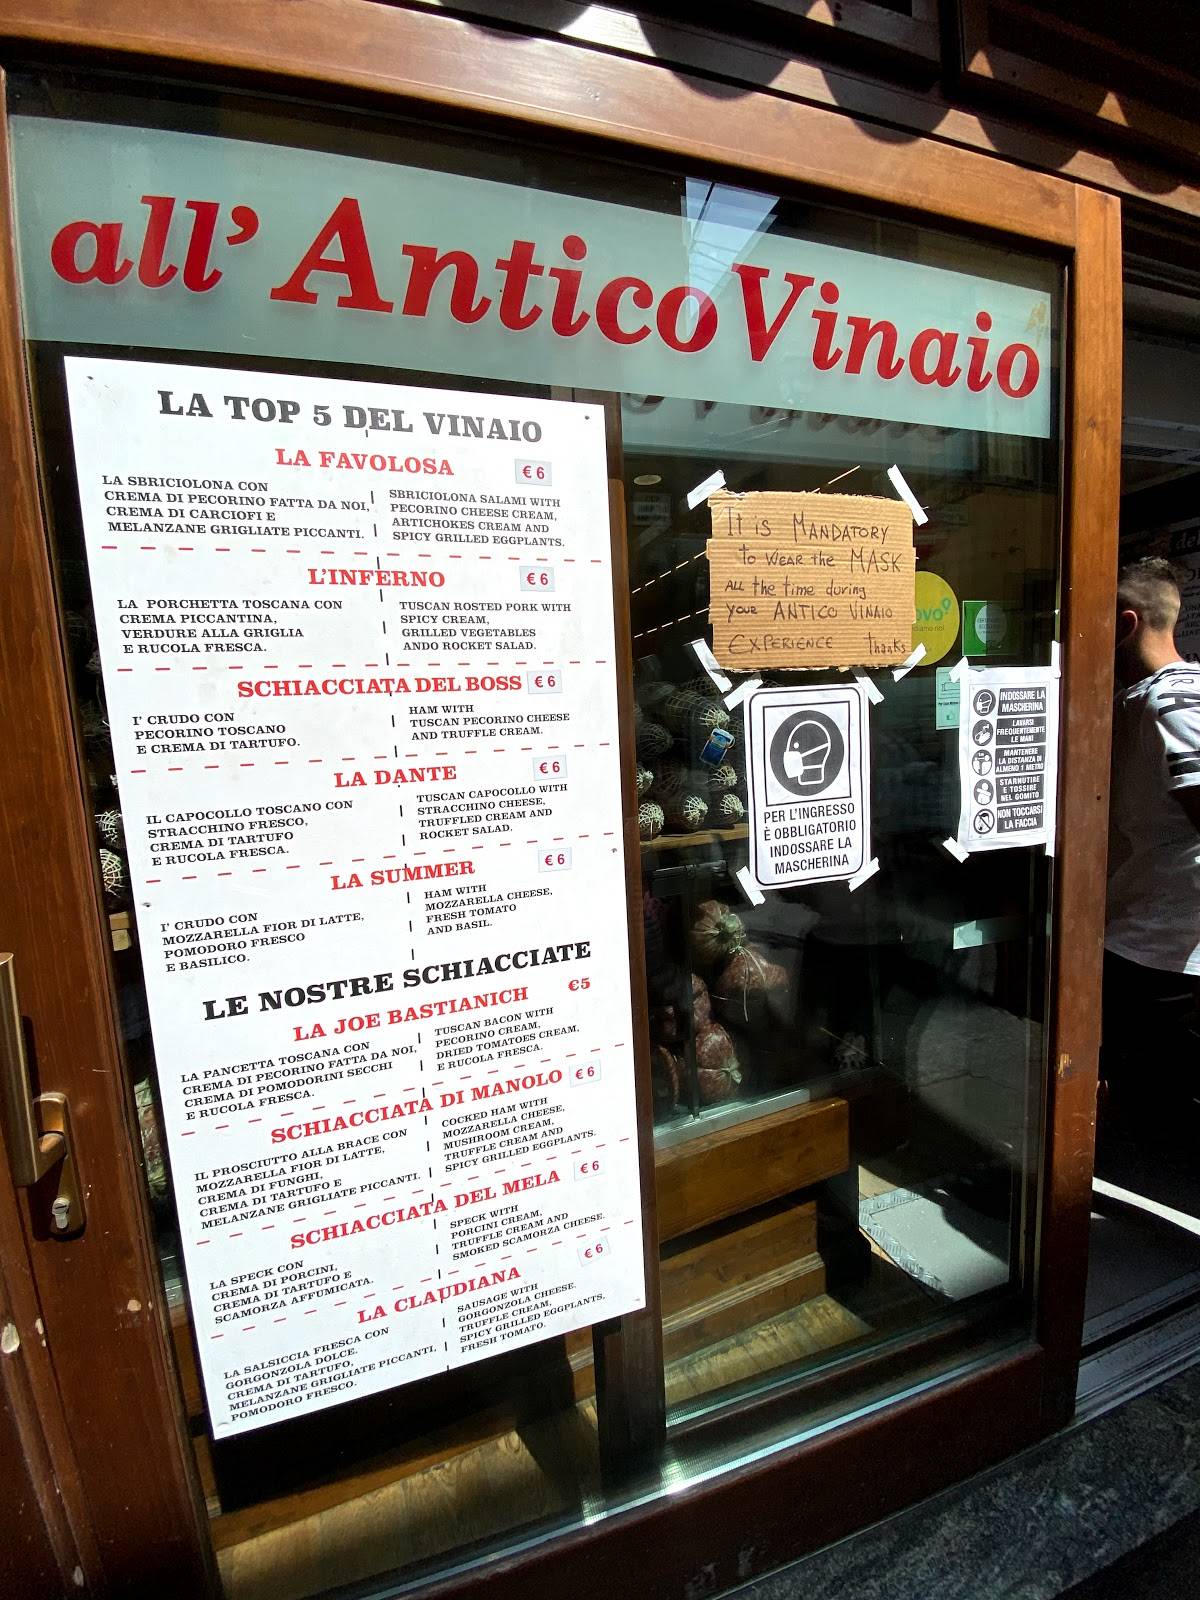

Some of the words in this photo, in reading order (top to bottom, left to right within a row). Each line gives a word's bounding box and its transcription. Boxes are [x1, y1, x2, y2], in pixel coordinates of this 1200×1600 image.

[50, 194, 260, 293] all’
[269, 196, 719, 353] Antico
[731, 262, 1041, 399] Vinaio
[157, 390, 213, 418] LA
[223, 395, 300, 424] TOP
[312, 404, 332, 426] 5
[342, 405, 413, 432] DEL
[422, 412, 542, 443] VINAIO
[274, 448, 311, 467] LA
[318, 451, 454, 476] FAVOLOSA
[102, 474, 123, 485] LA
[127, 476, 234, 490] SBRICIOLONA
[237, 481, 268, 492] CON
[104, 490, 163, 502] CREMA
[165, 492, 183, 503] DI
[187, 493, 266, 506] PECORINO
[269, 497, 314, 508] FATTA
[317, 499, 338, 509] DA
[340, 500, 370, 512] NOI,
[389, 489, 477, 503] SBRICIOLONA
[479, 494, 526, 505] SALAMI
[529, 497, 560, 507] WITH
[105, 506, 164, 517] CREMA
[167, 508, 185, 518] DI
[189, 509, 262, 521] CARCIOFI
[265, 511, 276, 521] E
[390, 503, 457, 515] PECORINO
[460, 506, 509, 517] CHEESE
[511, 509, 557, 521] CREAM,
[107, 521, 206, 534] MELANZANE
[210, 524, 290, 536] GRIGLIATE
[293, 527, 364, 539] PICCANTI.
[392, 517, 475, 530] ARTICHOKES
[478, 521, 521, 532] CREAM
[525, 523, 549, 533] AND
[724, 506, 743, 536] It
[793, 510, 889, 545] MANDATORY
[392, 531, 431, 541] SPICY
[434, 532, 489, 543] GRILLED
[492, 535, 565, 546] EGGPLANTS.
[738, 543, 757, 565] to
[811, 550, 836, 567] the
[850, 546, 902, 574] MASK
[307, 568, 445, 587] L’INFERNO
[725, 579, 745, 592] ALL
[752, 575, 776, 596] the
[783, 575, 815, 596] time
[825, 578, 867, 599] during
[773, 600, 838, 621] ANTICO
[849, 600, 893, 620] VINAIO
[728, 633, 833, 654] EXPERIENCE
[237, 677, 412, 694] SCHIACCIATA
[414, 676, 461, 692] DEL
[464, 675, 522, 691] BOSS
[1000, 690, 1036, 701] INDOSSARE
[1036, 690, 1046, 700] LA
[1001, 702, 1044, 713] MASCHERINA
[996, 726, 1046, 736] FREQUENTEMENTE
[1012, 719, 1035, 727] LAVARSI
[1003, 747, 1039, 757] MANTENERE
[1007, 756, 1036, 765] DISTANZA
[333, 771, 367, 788] LA
[373, 765, 457, 785] DANTE
[995, 765, 1019, 773] ALMENO
[999, 775, 1040, 785] STARNUTIRE
[1009, 784, 1037, 793] TOSSIRE
[416, 791, 465, 803] TUSCAN
[468, 786, 536, 799] CAPOCOLLO
[538, 783, 567, 793] WITH
[1000, 794, 1013, 802] NEL
[1014, 791, 1040, 800] GOMITO
[417, 801, 496, 816] STRACCHINO
[498, 797, 546, 809] CHEESE,
[764, 810, 786, 824] PER
[789, 802, 855, 820] L’INGRESSO
[997, 808, 1011, 819] NON
[1012, 804, 1043, 817] TOCCARSI
[418, 814, 482, 828] TRUFFLED
[485, 810, 526, 822] CREAM
[529, 808, 553, 818] AND
[1004, 820, 1013, 829] LA
[1014, 817, 1038, 829] FACCIA
[419, 827, 469, 840] ROCKET
[472, 824, 513, 835] SALAD.
[774, 819, 856, 840] OBBLIGATORIO
[770, 838, 834, 858] INDOSSARE
[838, 836, 852, 849] LA
[775, 854, 849, 875] MASCHERINA
[330, 873, 364, 890] LA
[370, 860, 476, 886] SUMMER
[161, 925, 260, 946] MOZZARELLA
[262, 920, 297, 933] FIOR
[300, 918, 316, 928] DI
[318, 912, 364, 926] LATTE,
[174, 916, 225, 931] CRUDO
[228, 912, 258, 924] CON
[163, 940, 247, 959] POMODORO
[250, 932, 305, 948] FRESCO
[165, 963, 176, 972] E
[178, 953, 250, 971] BASILICO.
[202, 995, 249, 1021] LE
[257, 972, 394, 1012] NOSTRE
[402, 940, 591, 988] SCHIACCIATE
[292, 1023, 327, 1042] LA
[333, 1012, 381, 1034] JOE
[386, 986, 528, 1025] BASTIANICH
[270, 1098, 434, 1144] SCHIACCIATA
[439, 1089, 464, 1108] DI
[470, 1069, 563, 1101] MANOLO
[290, 1198, 448, 1249] SCHIACCIATA
[453, 1186, 497, 1208] DEL
[501, 1170, 560, 1196] MELA
[209, 1279, 228, 1290] LA
[230, 1267, 274, 1285] SPECK
[277, 1259, 303, 1273] CON
[211, 1283, 259, 1301] CREMA
[262, 1278, 277, 1289] DI
[280, 1263, 338, 1284] PORCINI,
[213, 1295, 261, 1313] CREMA
[264, 1289, 278, 1300] DI
[281, 1274, 340, 1295] TARTUFO
[343, 1270, 352, 1279] E
[214, 1299, 287, 1324] SCAMORZA
[290, 1277, 374, 1305] AFFUMICATA.
[356, 1304, 388, 1324] LA
[393, 1266, 521, 1312] CLAUDIANA
